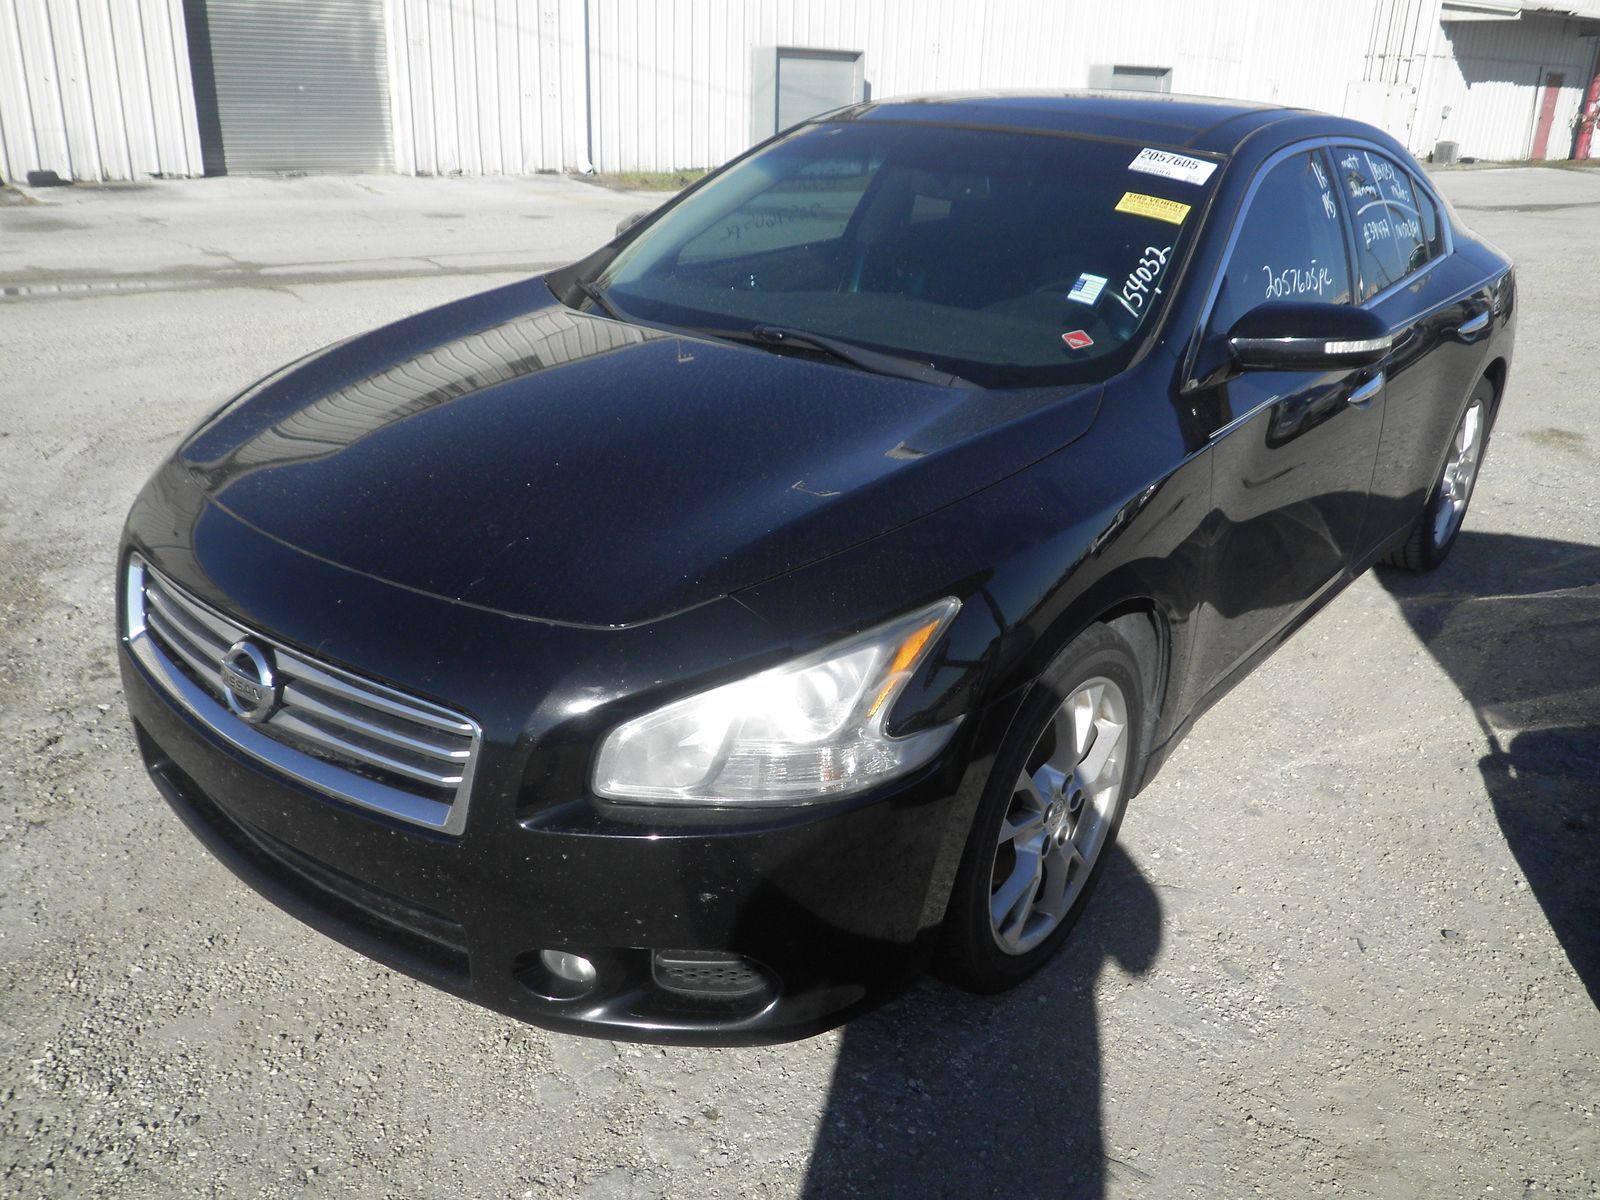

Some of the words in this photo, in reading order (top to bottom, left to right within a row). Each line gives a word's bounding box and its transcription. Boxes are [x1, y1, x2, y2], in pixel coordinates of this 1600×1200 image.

[1140, 150, 1200, 170] 2057605
[1128, 193, 1148, 202] THIS
[1149, 197, 1187, 211] VEHICLE
[223, 670, 262, 700] NISSAN
